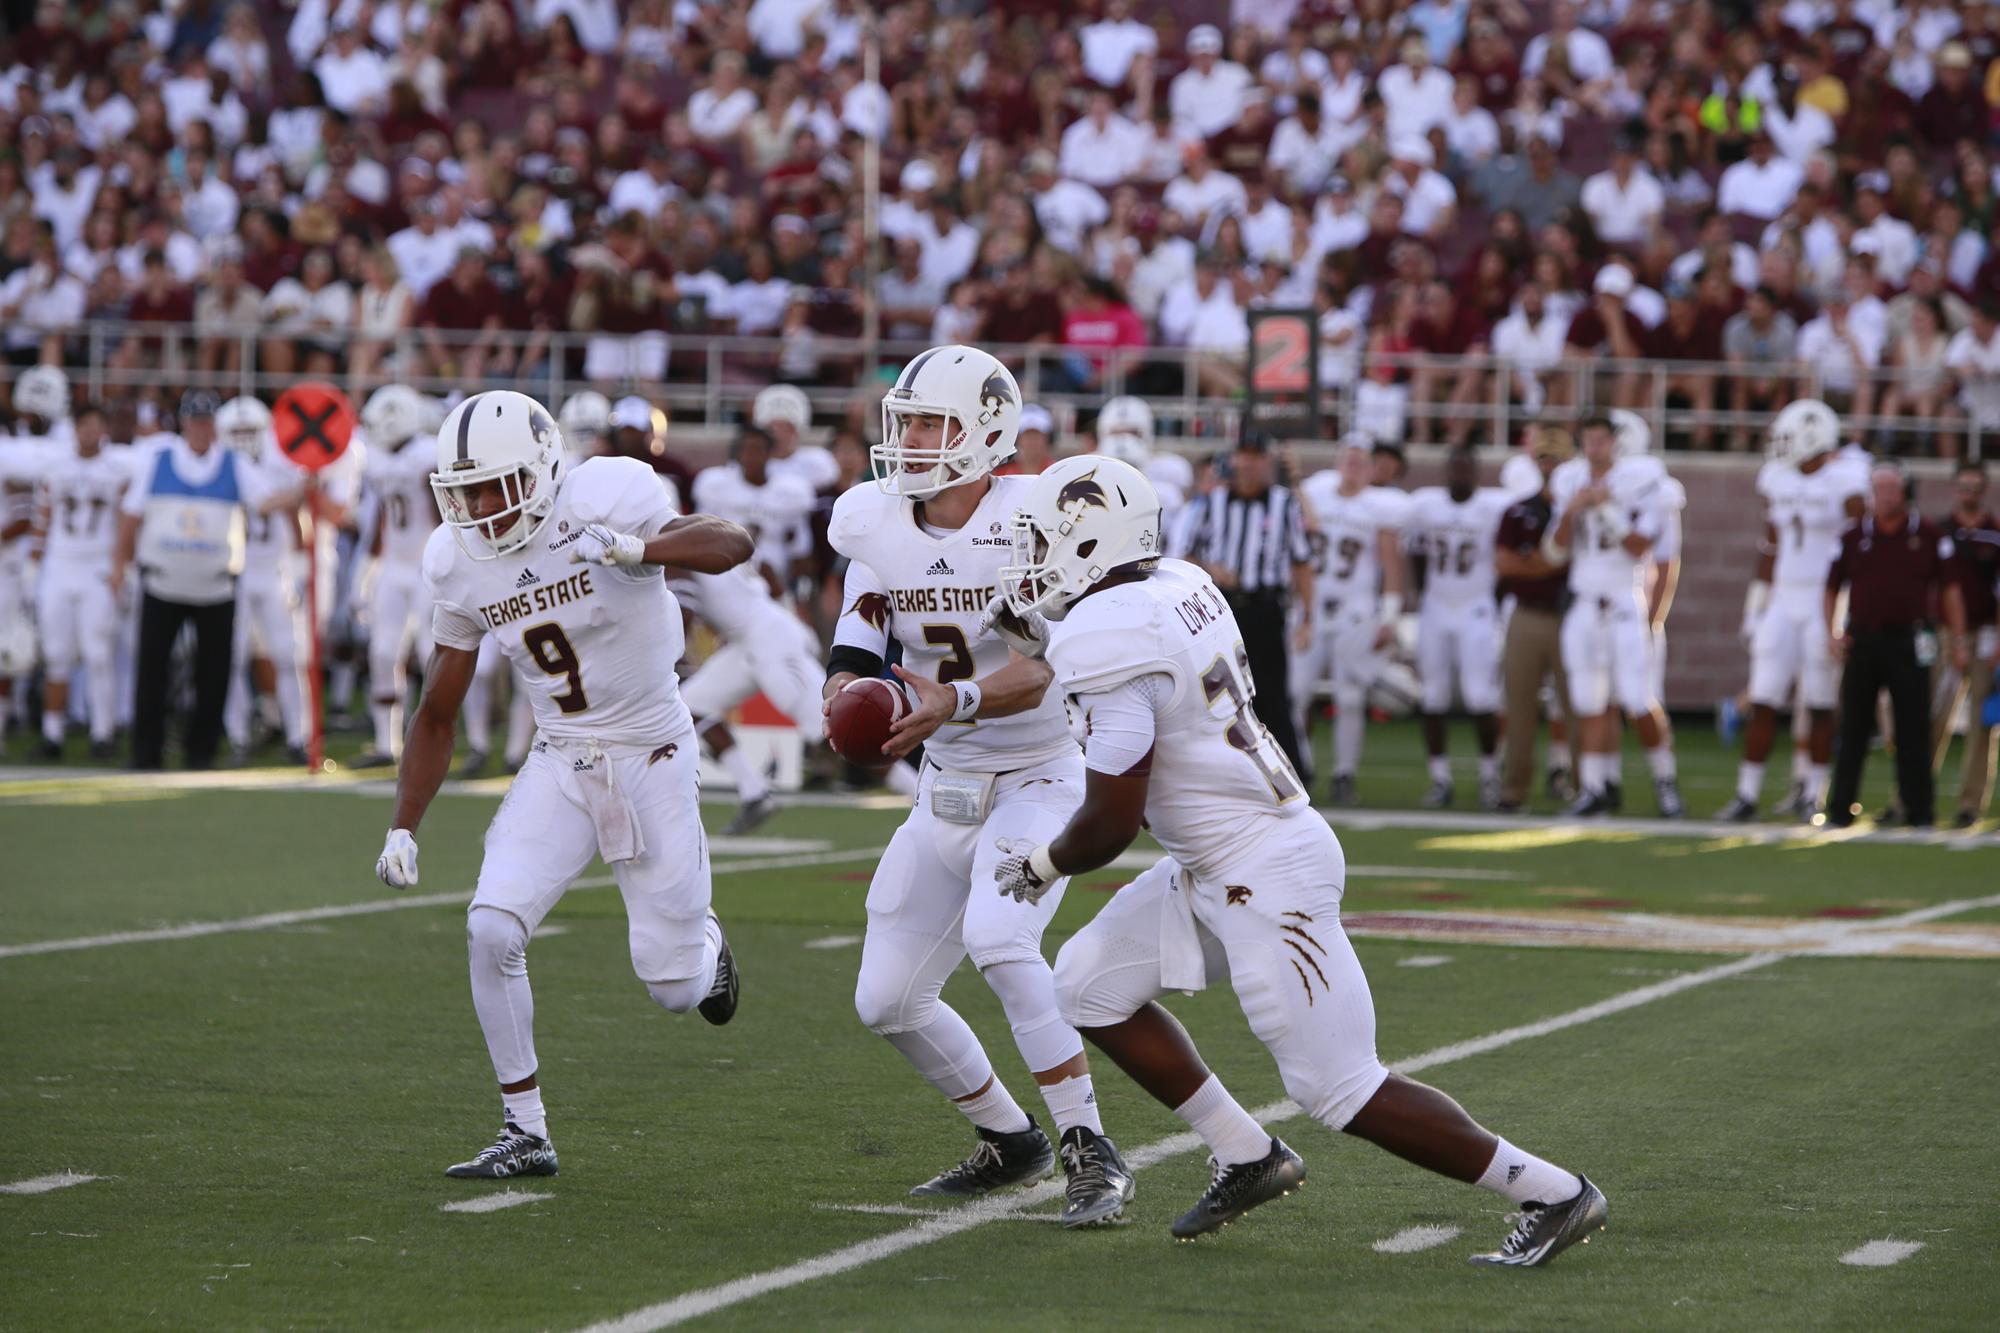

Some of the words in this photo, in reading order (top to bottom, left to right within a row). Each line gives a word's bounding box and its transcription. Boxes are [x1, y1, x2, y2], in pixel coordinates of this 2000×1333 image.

[1252, 314, 1311, 392] 2
[948, 432, 968, 450] iddell
[926, 568, 955, 576] adidas
[479, 593, 533, 629] TEXAS
[534, 569, 594, 612] STATE
[889, 588, 938, 612] TEXAS
[943, 586, 996, 612] STATE
[1174, 592, 1216, 636] LOWE
[522, 620, 590, 717] 9
[921, 623, 978, 728] 2
